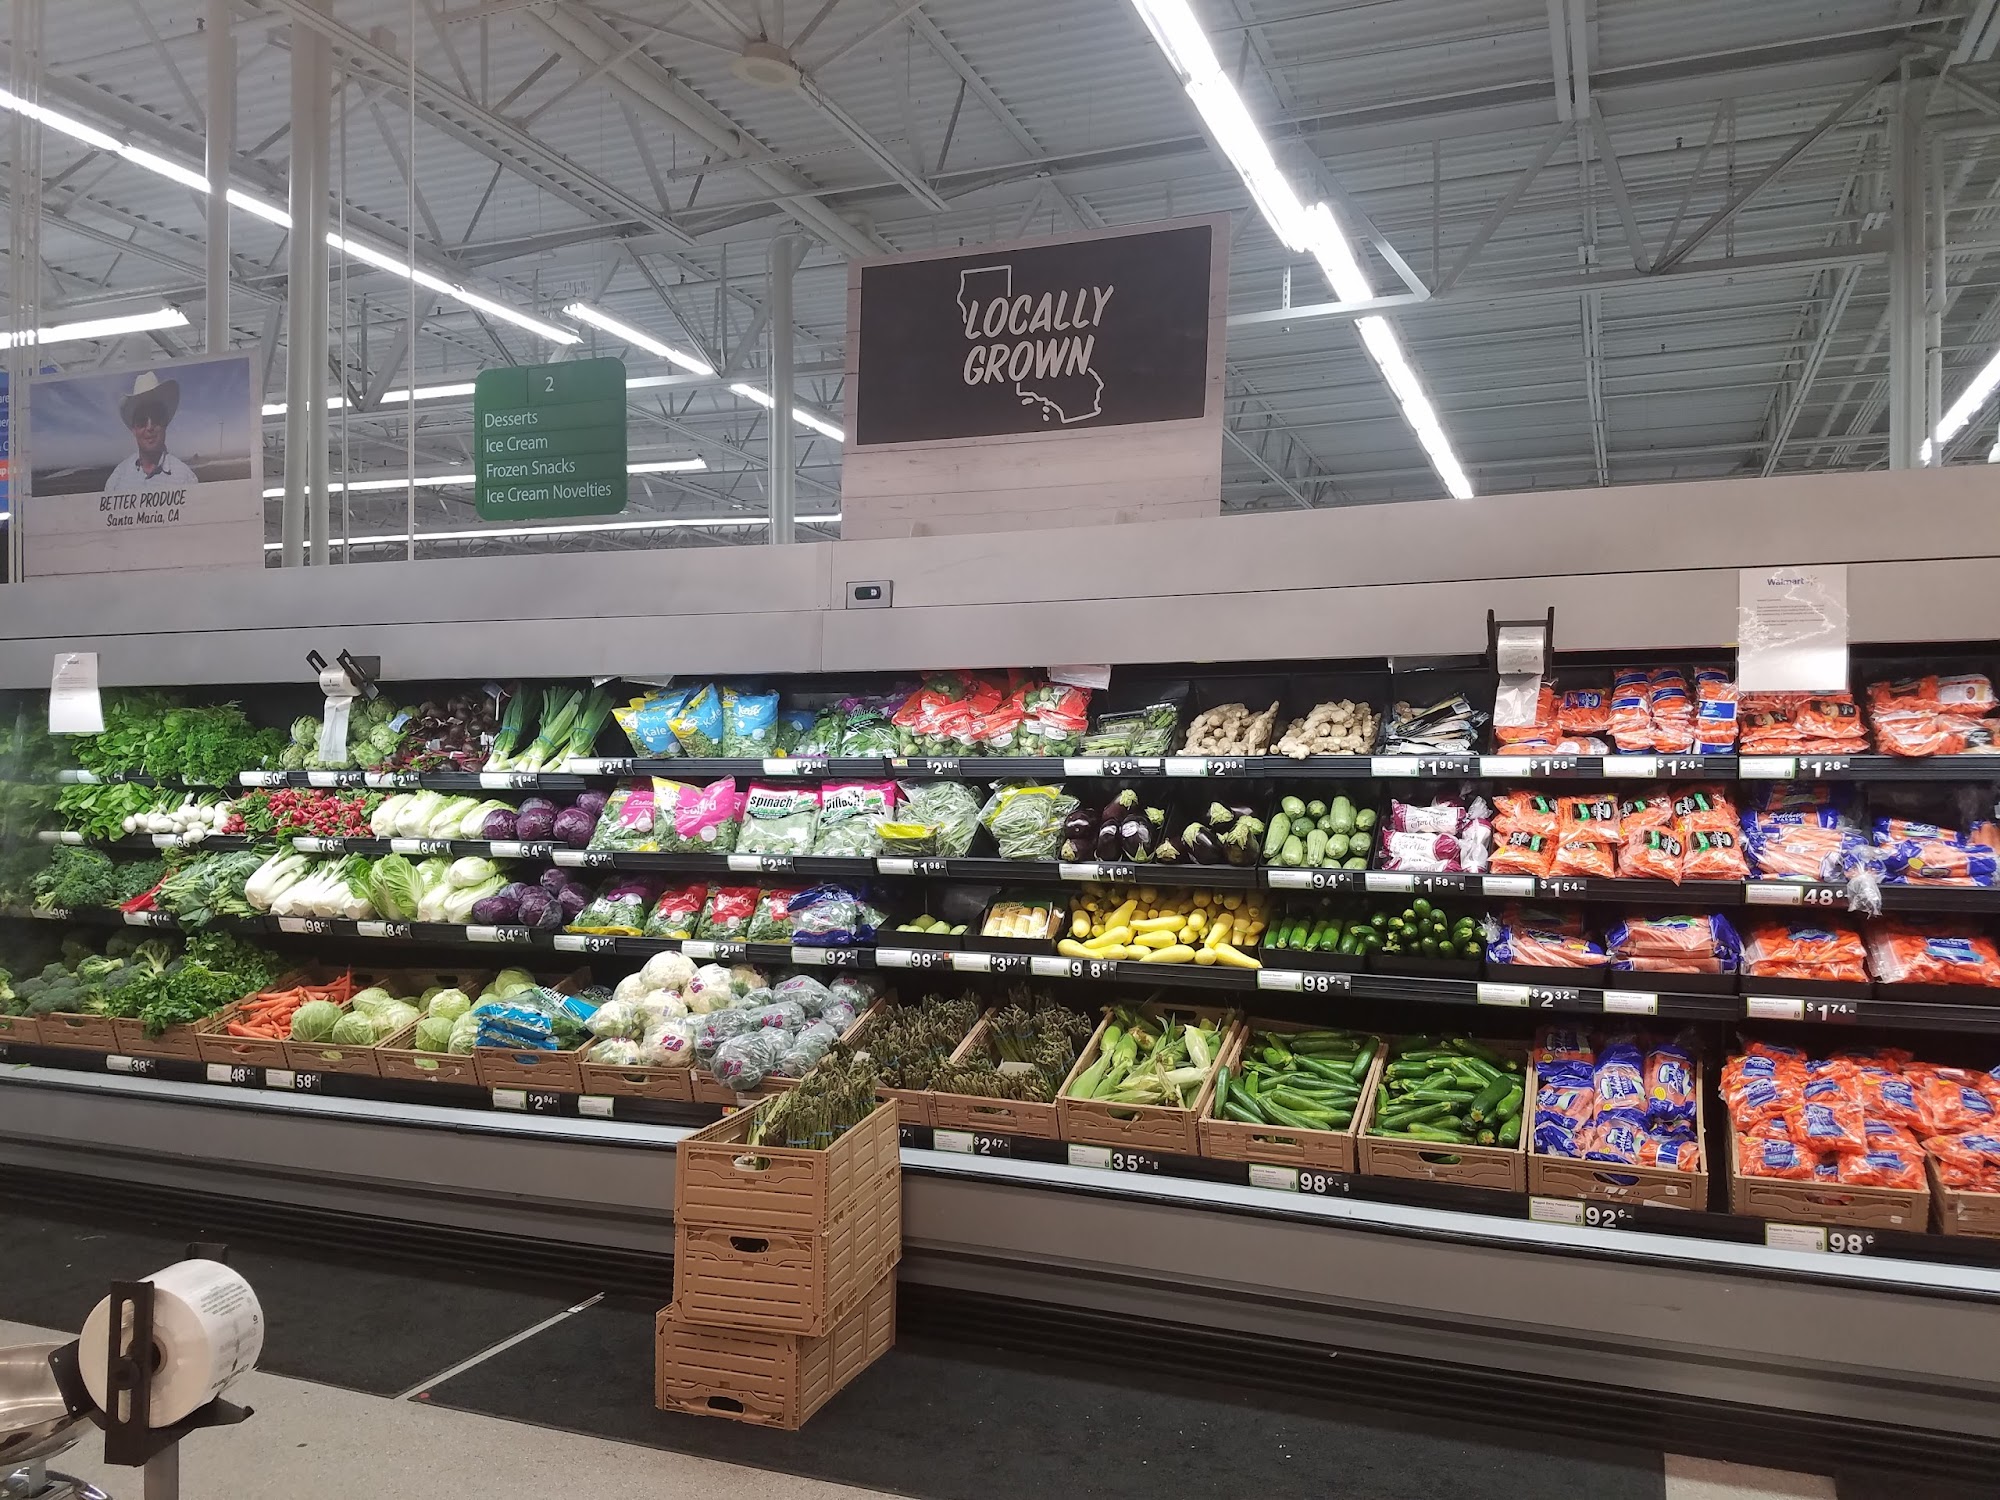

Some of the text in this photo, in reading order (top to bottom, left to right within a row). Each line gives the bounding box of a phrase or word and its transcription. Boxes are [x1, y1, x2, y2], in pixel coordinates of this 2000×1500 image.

[965, 285, 1114, 340] LOCALLY
[964, 334, 1095, 386] GROWN
[545, 376, 554, 392] 2
[484, 411, 538, 428] Desserts
[486, 436, 548, 453] Ice Cream
[486, 457, 576, 478] Frozen Snacks
[100, 489, 187, 512] BETTER PRODUCE
[486, 481, 612, 503] Ice Cream Novelties
[106, 508, 180, 527] Santa Maria, CA
[702, 708, 722, 728] Kale
[643, 726, 667, 737] Kale
[750, 795, 793, 808] spinach
